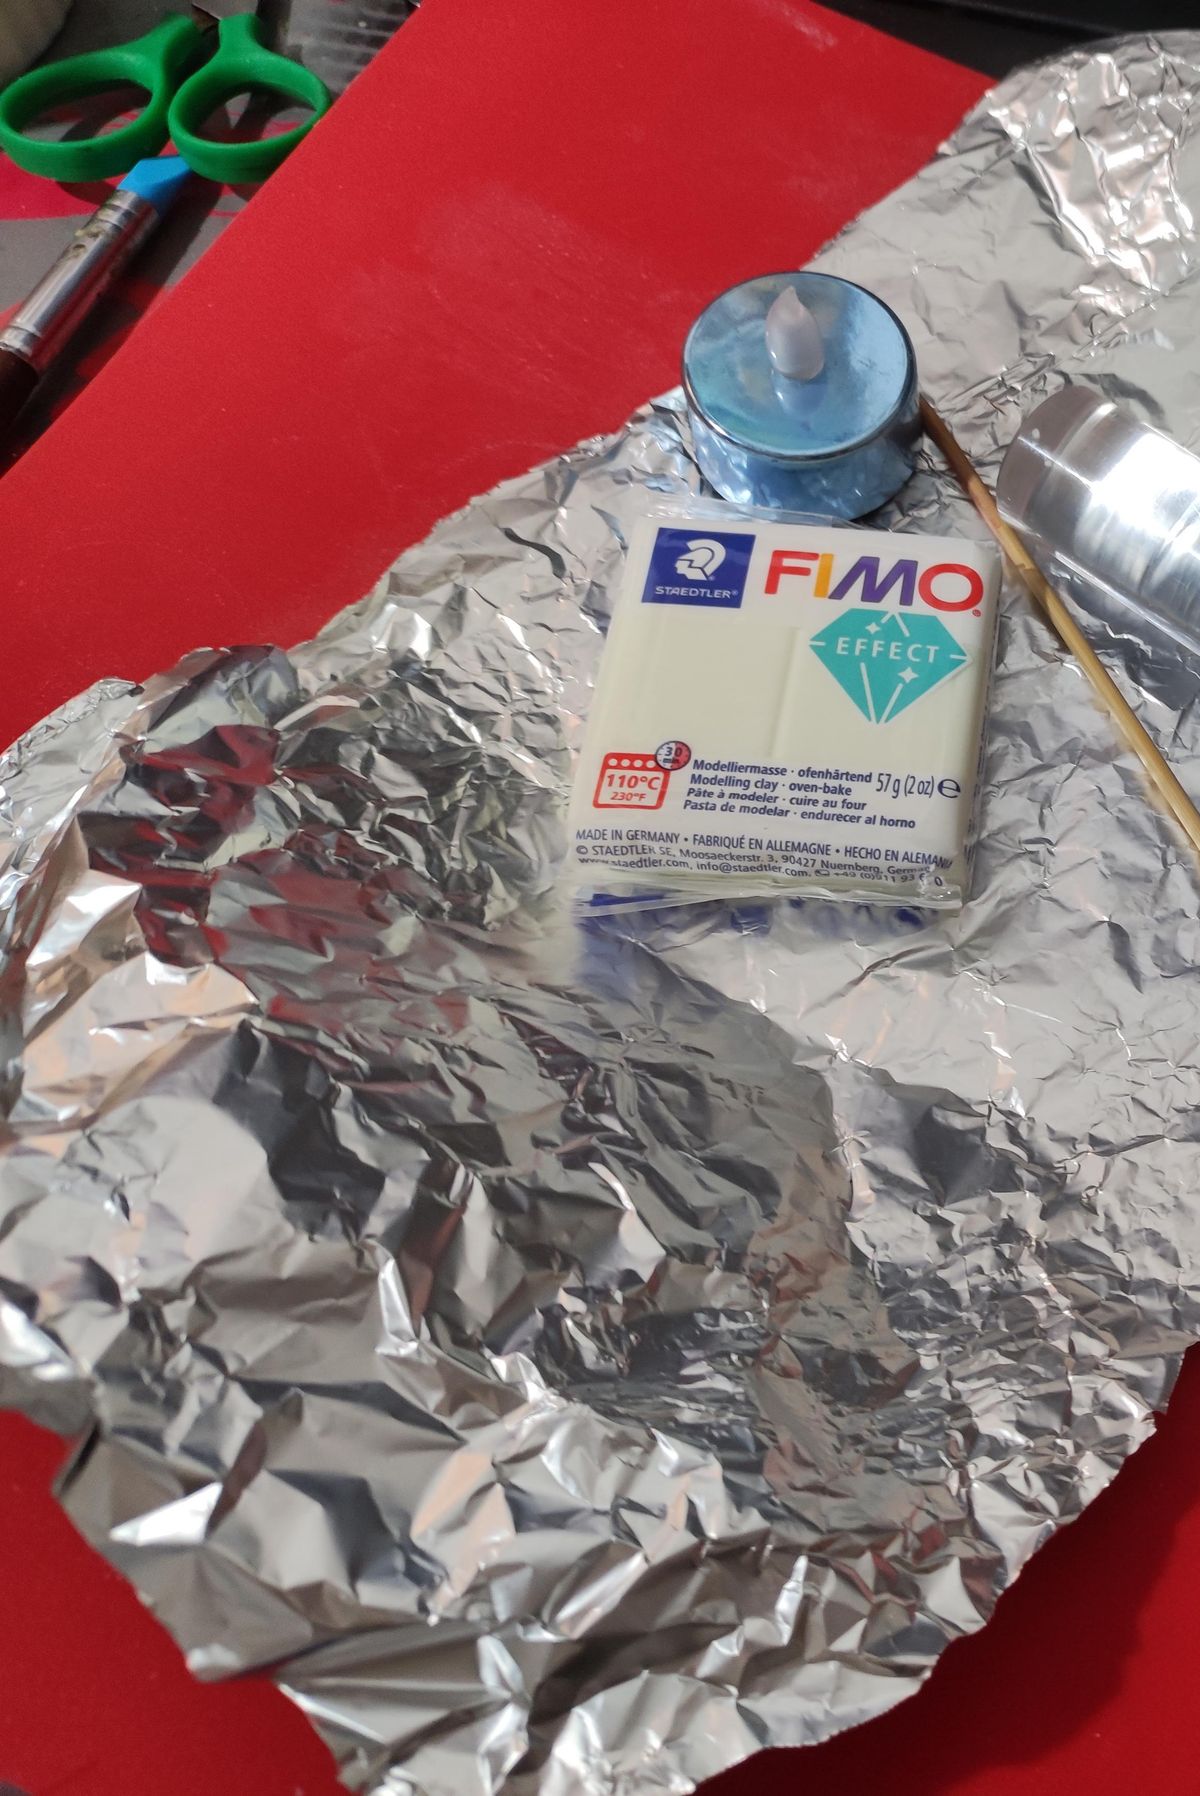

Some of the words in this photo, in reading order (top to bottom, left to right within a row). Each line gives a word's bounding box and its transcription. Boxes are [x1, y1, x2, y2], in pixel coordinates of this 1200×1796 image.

[836, 636, 940, 664] EFFECT
[664, 746, 683, 758] 30
[606, 774, 661, 791] 110°C
[692, 759, 788, 776] Modelliermasse
[797, 766, 873, 783] ofenhärtend
[610, 791, 647, 802] 230°F
[690, 773, 751, 791] Modelling
[754, 776, 779, 793] clay
[788, 781, 853, 796] oven-bake
[686, 787, 715, 798] Pâte
[717, 788, 725, 799] à
[728, 790, 779, 804] modeler
[788, 795, 820, 807] cuire
[822, 798, 838, 808] au
[840, 799, 867, 811] four
[683, 799, 717, 812] Pasta
[720, 801, 736, 813] de
[738, 803, 790, 817] modelar
[800, 810, 862, 824] endurecer
[864, 814, 877, 825] al
[879, 815, 916, 829] horno
[575, 828, 608, 841] MADE
[611, 829, 623, 841] IN
[626, 829, 680, 844] GERMANY
[692, 833, 745, 849] FABRIQUÉ
[748, 838, 763, 850] EN
[765, 838, 831, 856] ALLEMAGNE
[844, 845, 882, 861] HECHO
[884, 849, 900, 862] EN
[591, 844, 656, 856] STAEDTLER
[679, 848, 765, 863] Moosaeckerstr.
[781, 854, 817, 868] 90427
